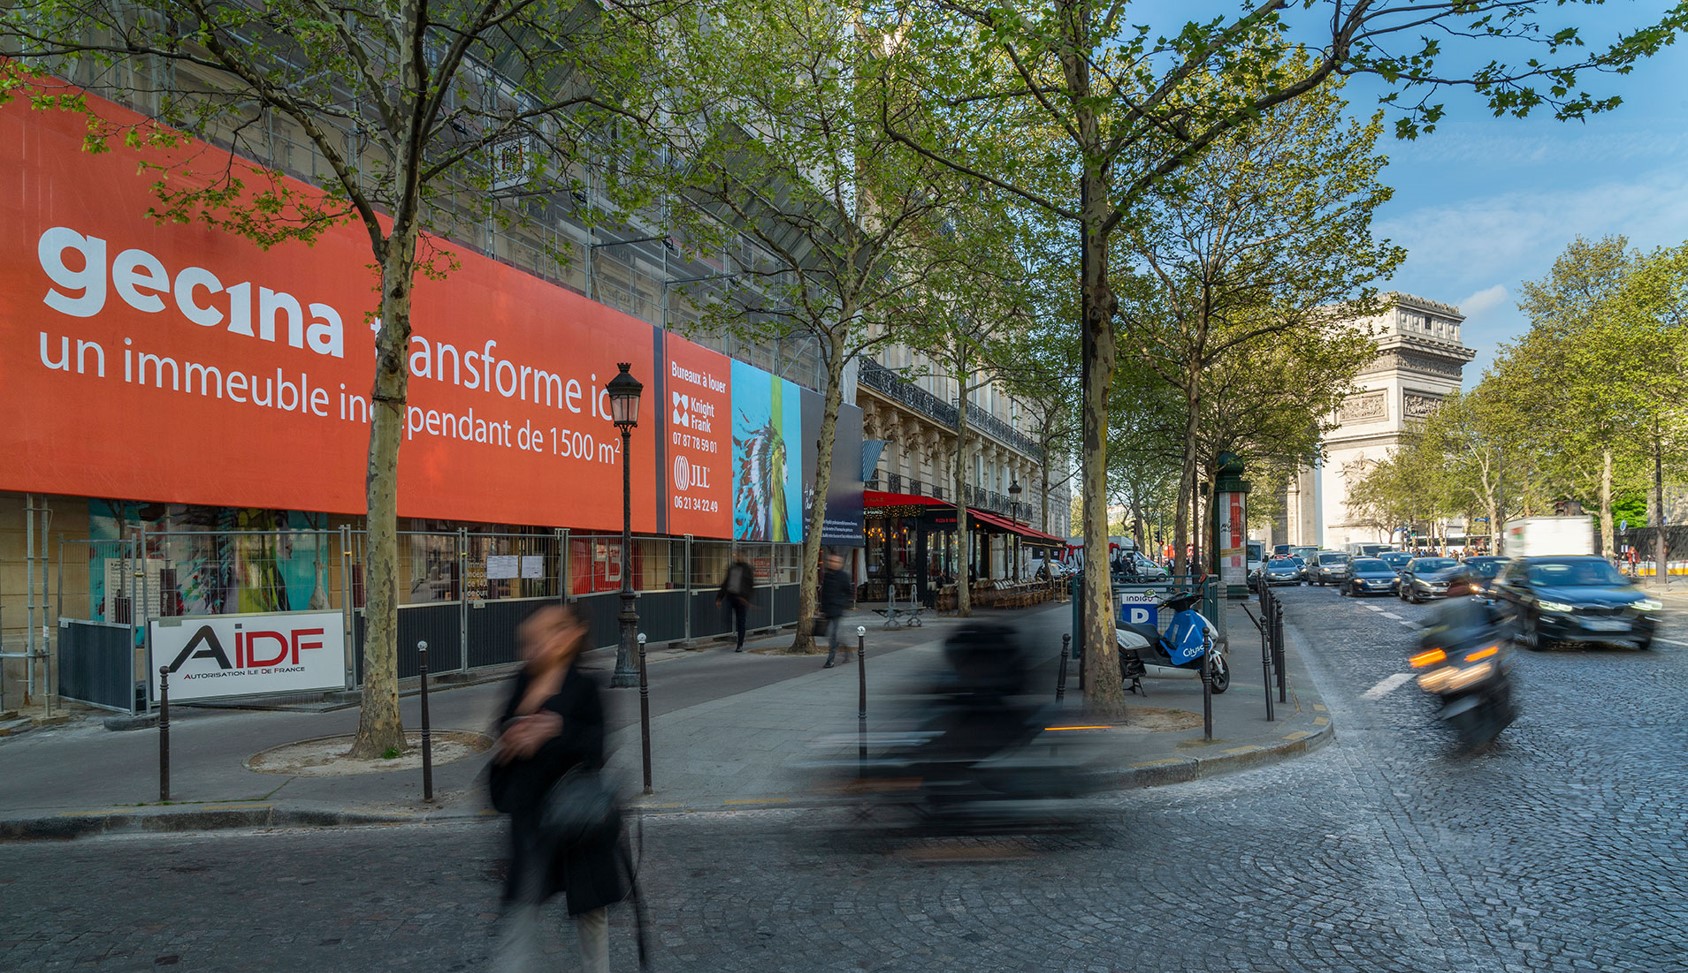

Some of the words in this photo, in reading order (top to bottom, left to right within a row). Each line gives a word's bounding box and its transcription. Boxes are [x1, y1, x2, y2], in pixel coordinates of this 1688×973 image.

[370, 316, 582, 414] ansforme
[591, 373, 613, 421] ic
[672, 361, 702, 386] Bureaux
[702, 371, 708, 388] à
[708, 374, 727, 393] louer
[40, 332, 105, 377] un
[124, 337, 329, 417] immeuble
[340, 383, 512, 448] inpendant
[517, 420, 544, 453] de
[550, 428, 594, 461] 1500
[691, 397, 715, 419] Knight
[692, 414, 711, 433] Frank
[673, 431, 681, 446] 07
[682, 434, 691, 448] 87
[692, 436, 701, 450] 78
[701, 438, 710, 452] 59
[710, 440, 717, 454] 01
[674, 495, 683, 509] 06
[683, 496, 692, 510] 21
[693, 498, 701, 511] 34
[701, 499, 710, 512] 22
[710, 500, 719, 513] 49
[1182, 644, 1205, 658] Citysc
[274, 666, 305, 674] FRANCE
